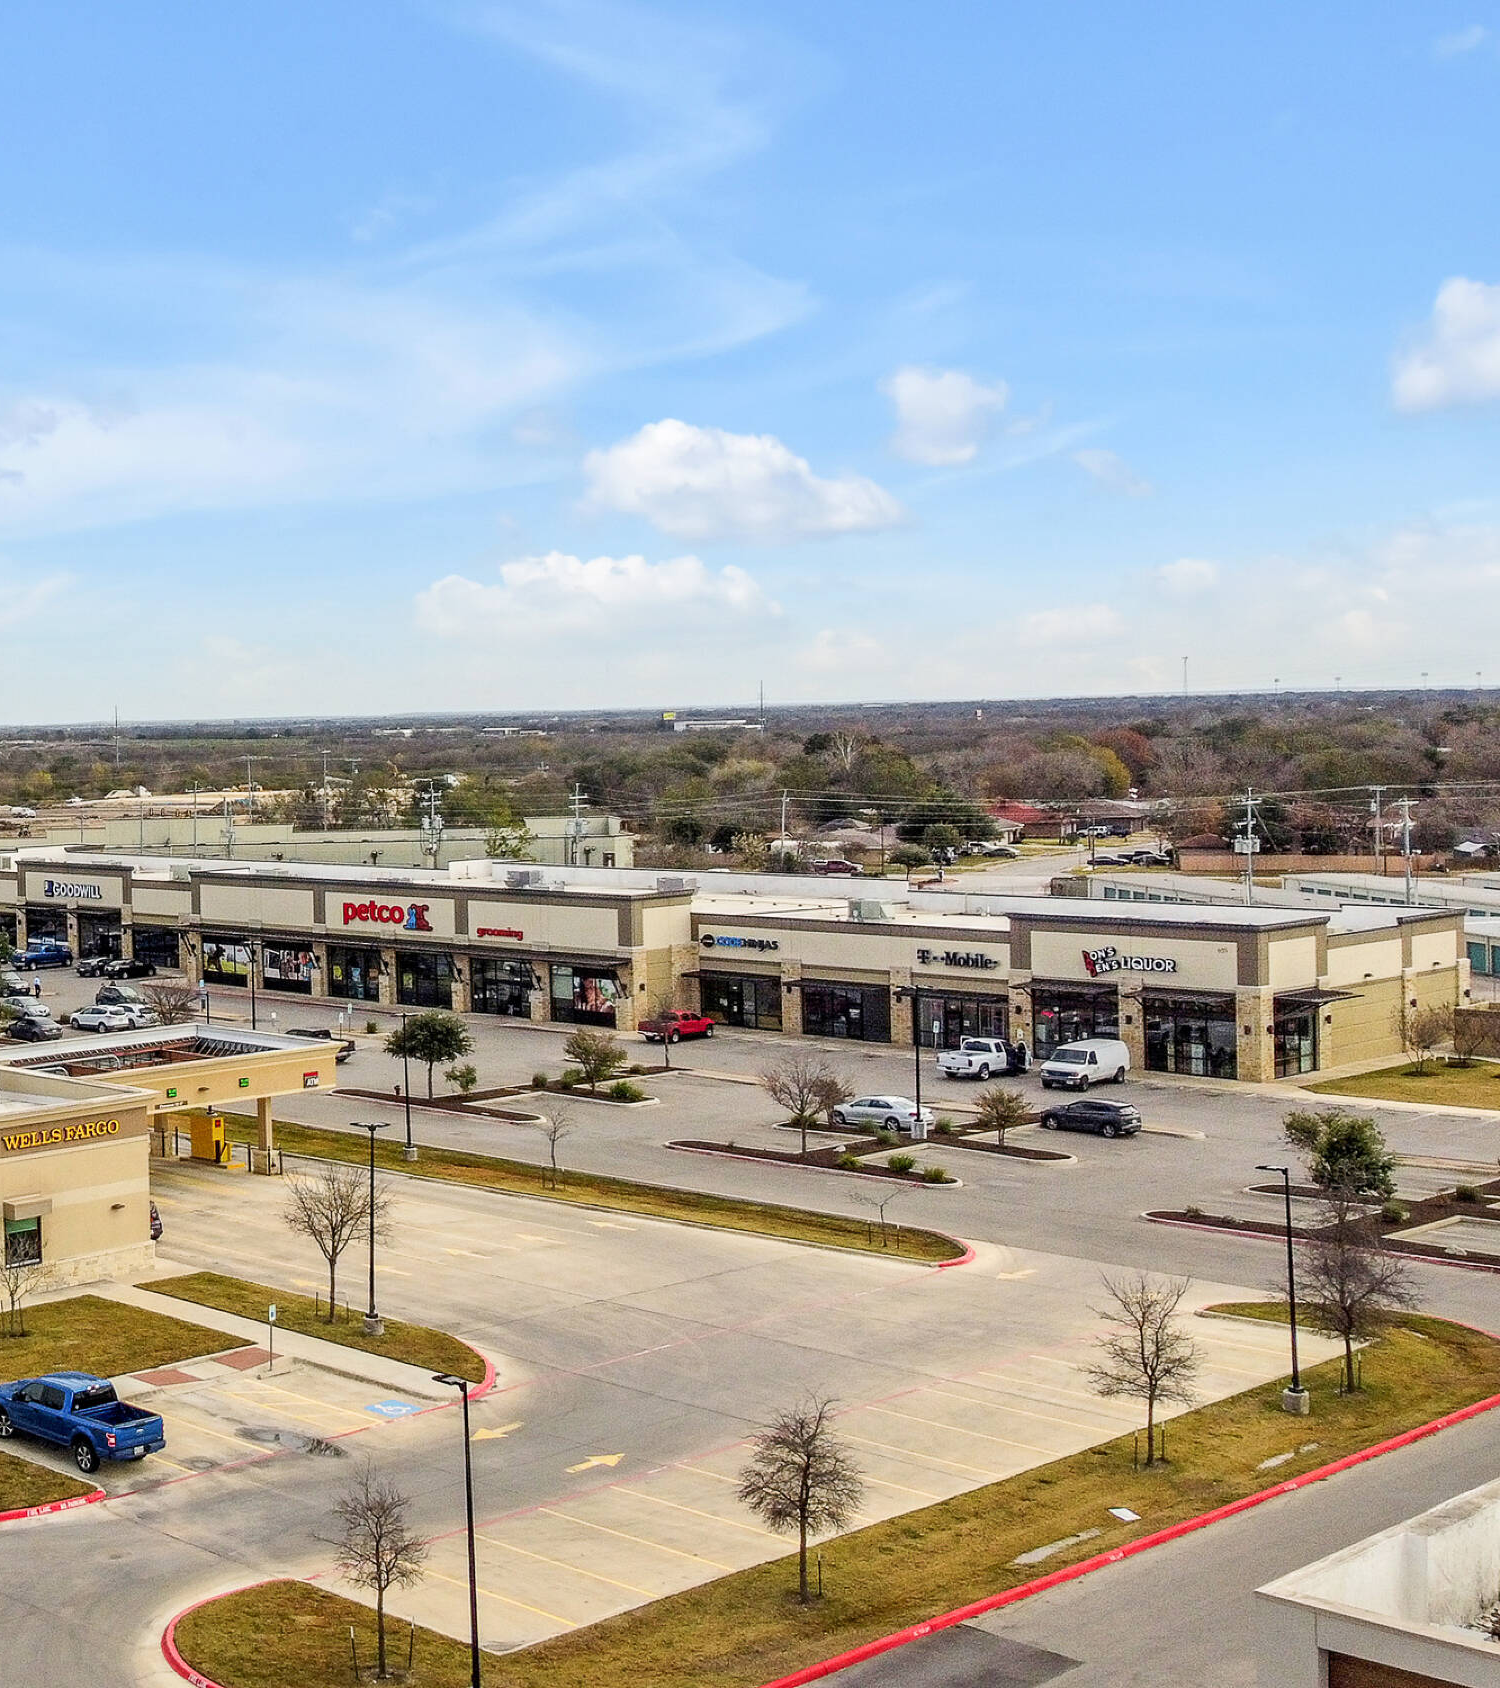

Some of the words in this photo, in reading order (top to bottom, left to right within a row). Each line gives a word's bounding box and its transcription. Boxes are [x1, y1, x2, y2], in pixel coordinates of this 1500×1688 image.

[53, 882, 101, 899] GOODWILL
[343, 901, 405, 925] petco
[477, 927, 523, 941] grooming
[1121, 957, 1177, 973] LIQUOR
[3, 1129, 62, 1151] WELLS
[65, 1120, 119, 1141] FARGO
